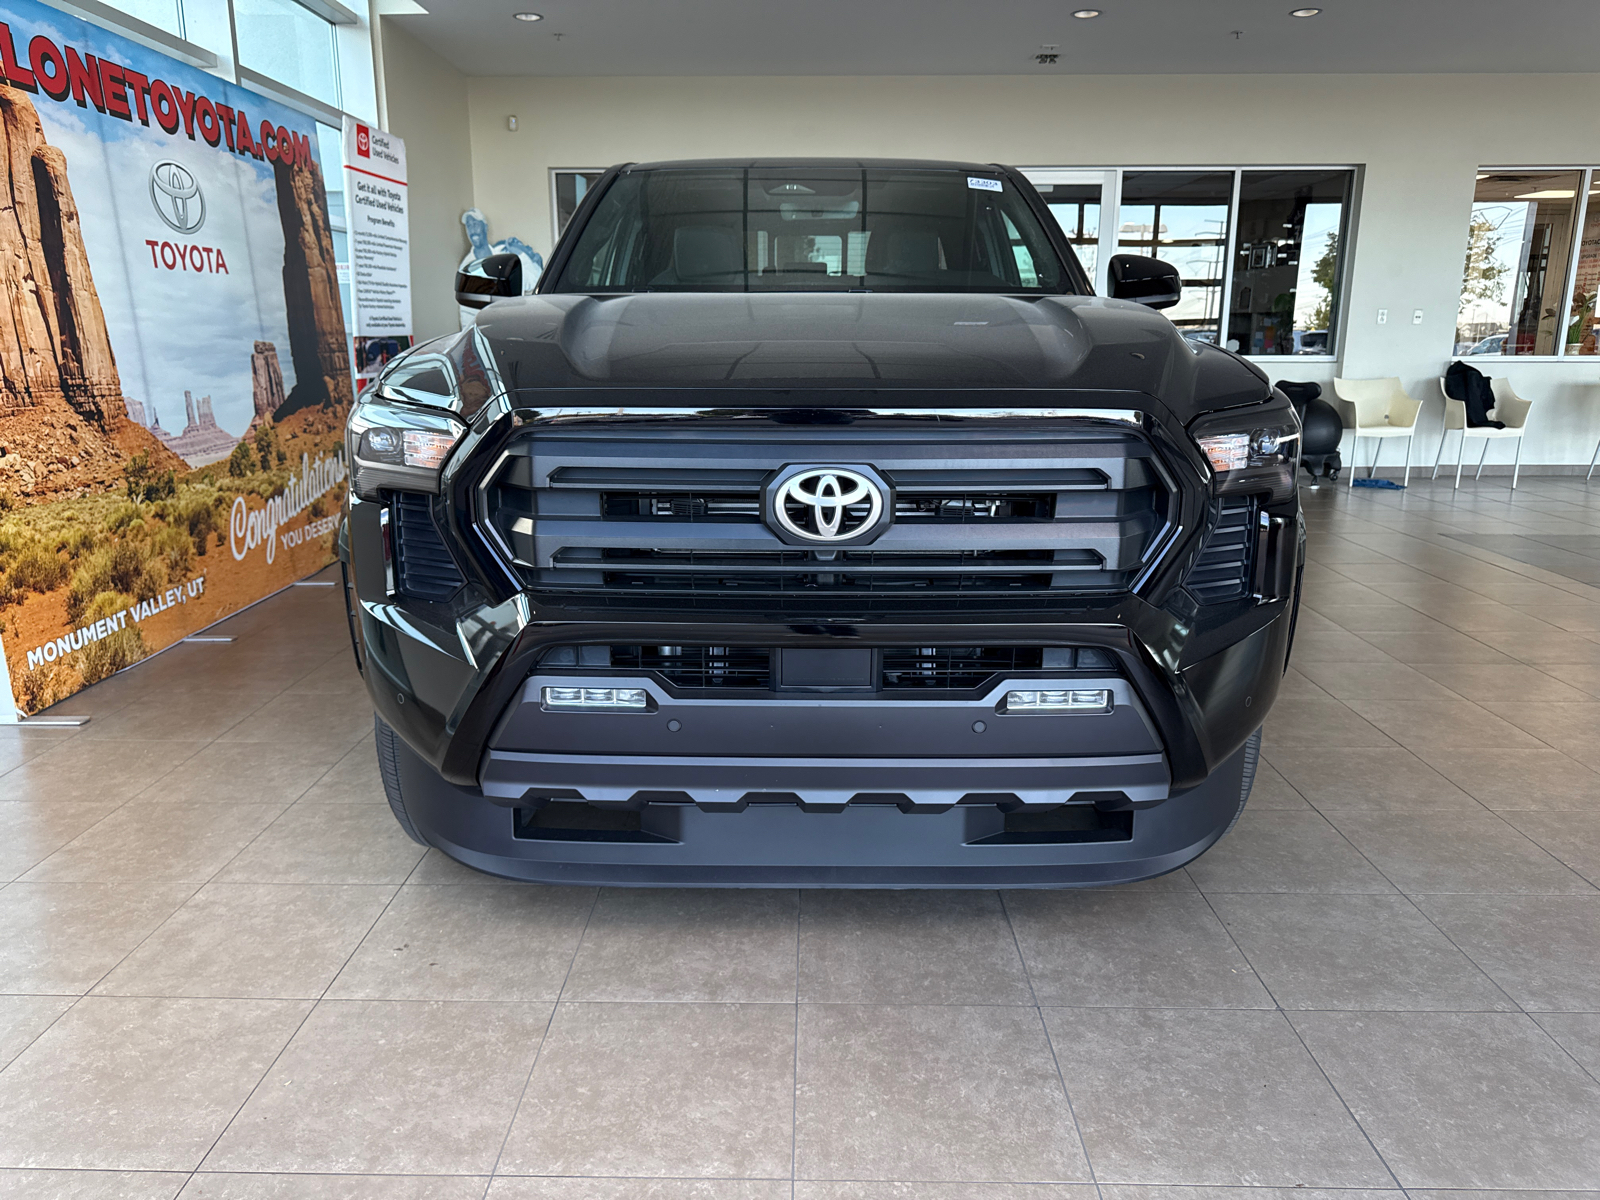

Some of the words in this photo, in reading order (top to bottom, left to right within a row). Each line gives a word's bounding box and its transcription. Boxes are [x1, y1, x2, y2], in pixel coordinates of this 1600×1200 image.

[0, 21, 313, 173] LONETOYOTA.COM
[371, 135, 390, 150] Certified
[372, 147, 384, 159] Used
[383, 151, 400, 165] Vehicles
[357, 181, 366, 192] Get
[377, 187, 387, 197] with
[387, 189, 402, 202] Toyota
[355, 194, 376, 208] Certified
[376, 199, 387, 211] Used
[387, 202, 404, 214] Vehicles
[145, 239, 229, 275] TOYOTA
[280, 528, 303, 550] YOU
[26, 609, 128, 671] MONUMENT
[129, 585, 187, 624] VALLEY,
[187, 576, 205, 598] UT
